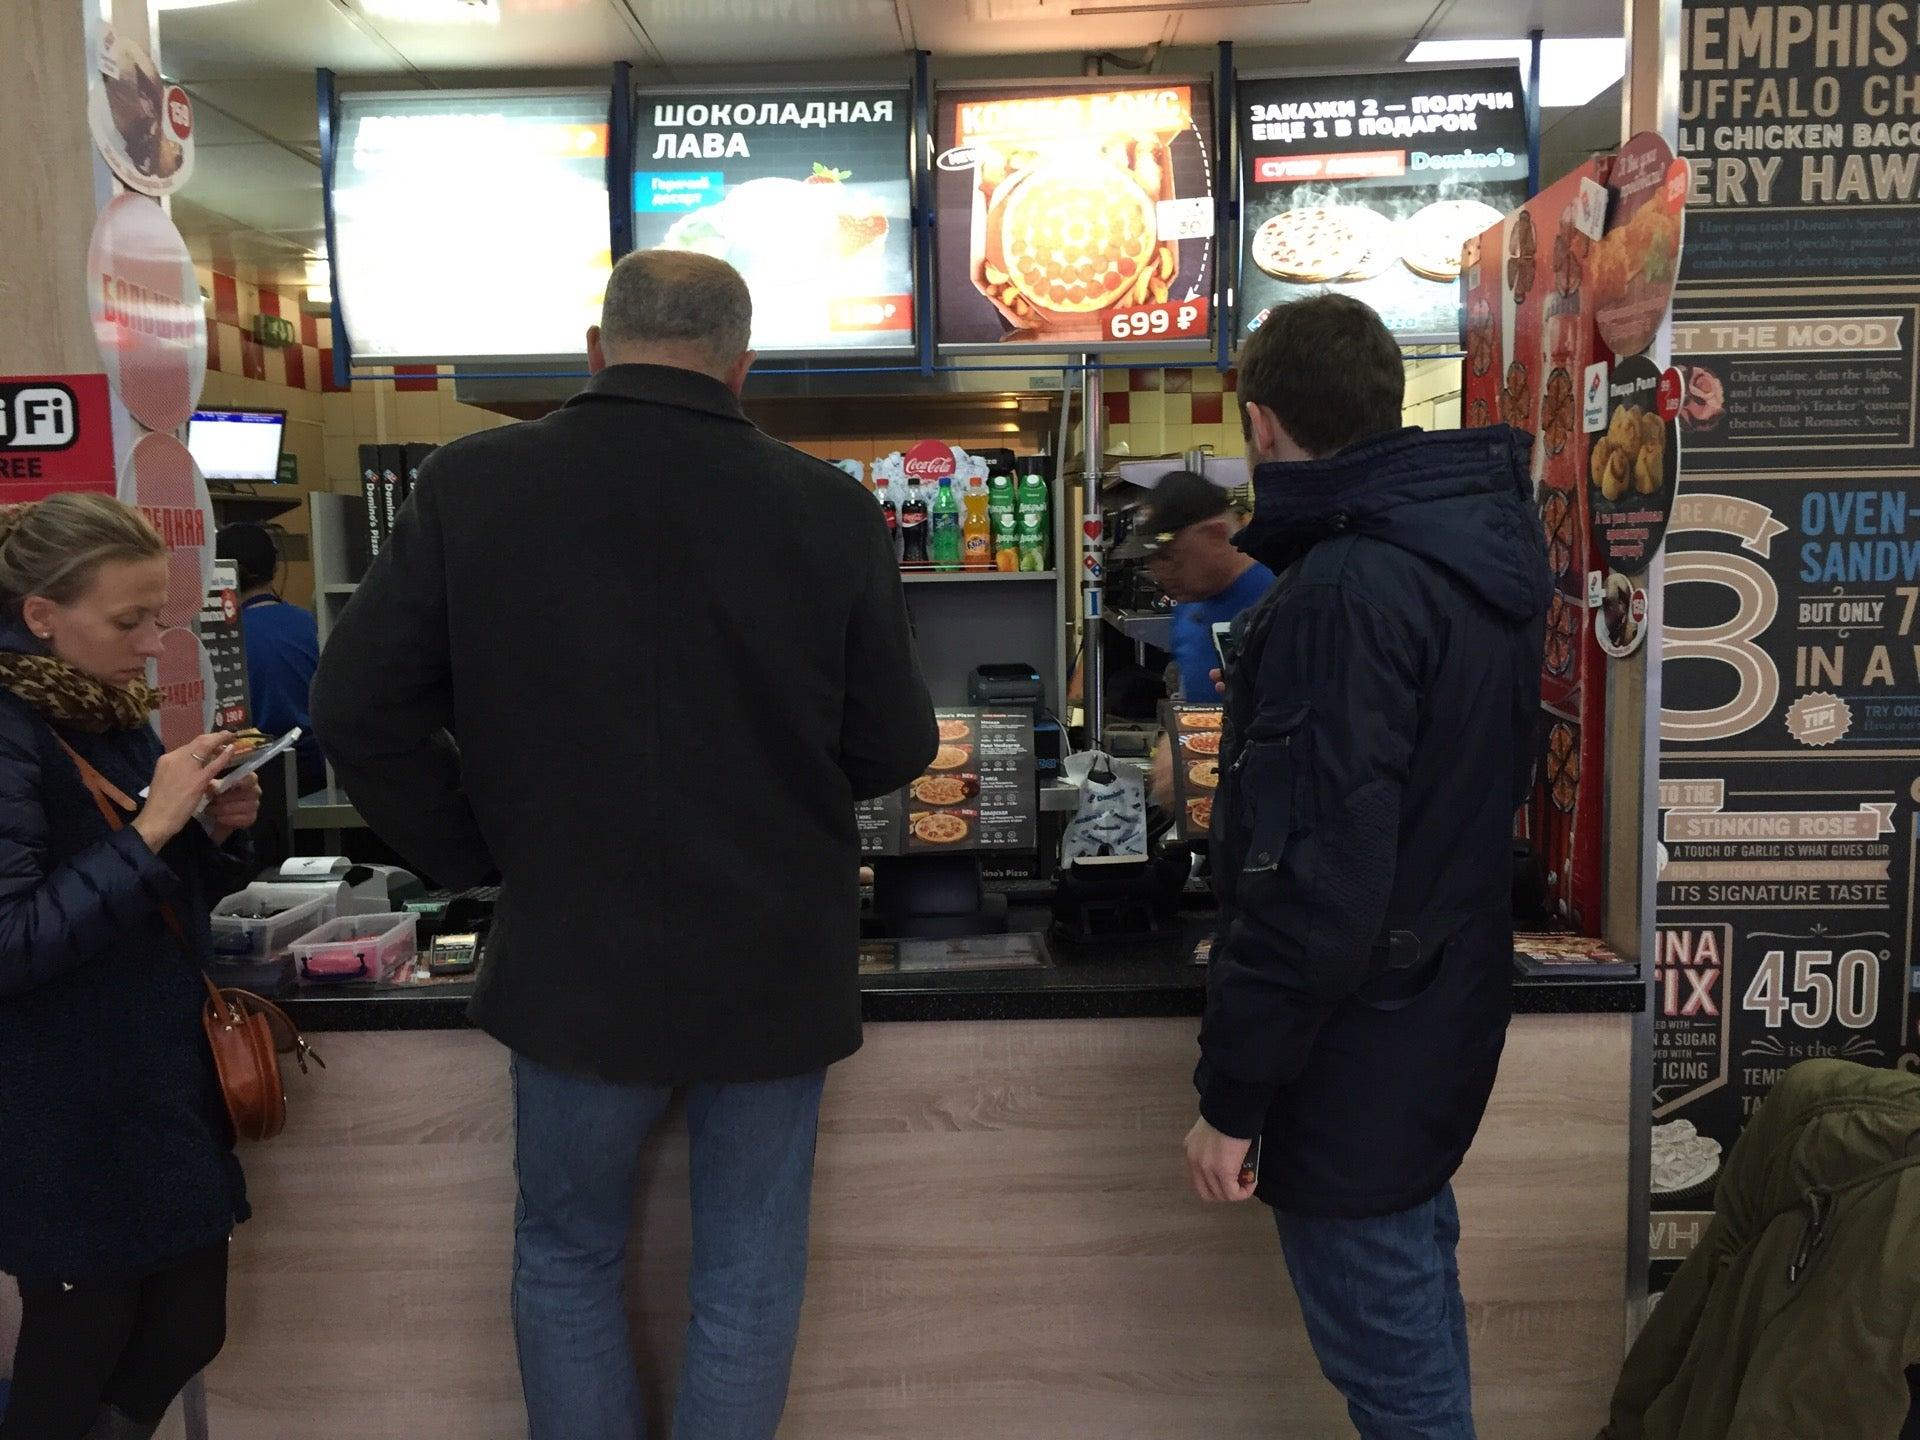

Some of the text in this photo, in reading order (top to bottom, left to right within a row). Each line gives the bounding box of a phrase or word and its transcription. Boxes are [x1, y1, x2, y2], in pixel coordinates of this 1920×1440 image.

[653, 100, 893, 128] ШОКОЛАДНАЯ
[1251, 100, 1356, 121] ЗАКАЖИ
[1362, 99, 1379, 117] 2
[1411, 92, 1514, 115] ПОЛУЧИ
[1252, 113, 1478, 143] ЕЩЕ 1 В ПОДАРОК
[1679, 127, 1705, 151] LI
[1714, 124, 1843, 150] CHICKEN
[652, 132, 750, 159] ЛАВА
[1411, 147, 1515, 170] Domino's
[1686, 157, 1783, 204] ERY
[1801, 153, 1920, 203] HAW
[1111, 309, 1169, 338] 699
[1710, 326, 1776, 348] THE
[1787, 324, 1887, 347] MOOD
[1730, 370, 1767, 382] Order
[1815, 369, 1839, 380] dim
[1842, 369, 1862, 380] the
[1729, 384, 1890, 400] and follow your order with
[0, 397, 65, 436] iFi
[1729, 403, 1748, 413] the
[1752, 401, 1809, 413] Domino's
[1779, 416, 1800, 428] like
[1804, 415, 1862, 428] Romance
[0, 457, 43, 479] REE
[1711, 503, 1750, 528] ARE
[1799, 602, 1834, 623] BUT
[1839, 602, 1884, 622] ONLY
[1796, 645, 1844, 686] IN
[1862, 645, 1895, 686] A
[1865, 705, 1889, 717] TRY
[1681, 785, 1714, 803] THE
[1687, 817, 1857, 836] STINKING ROSE
[1674, 844, 1890, 857] A TOUCH OF GARLIC IS WHAT GIVES OUR
[1671, 884, 1888, 901] ITS SIGNATURE TASTE
[1668, 1019, 1690, 1029] WITH
[1662, 1033, 1671, 1046] &
[1675, 1032, 1717, 1046] SUGAR
[1789, 1040, 1837, 1057] is the
[1662, 1062, 1708, 1080] ICING
